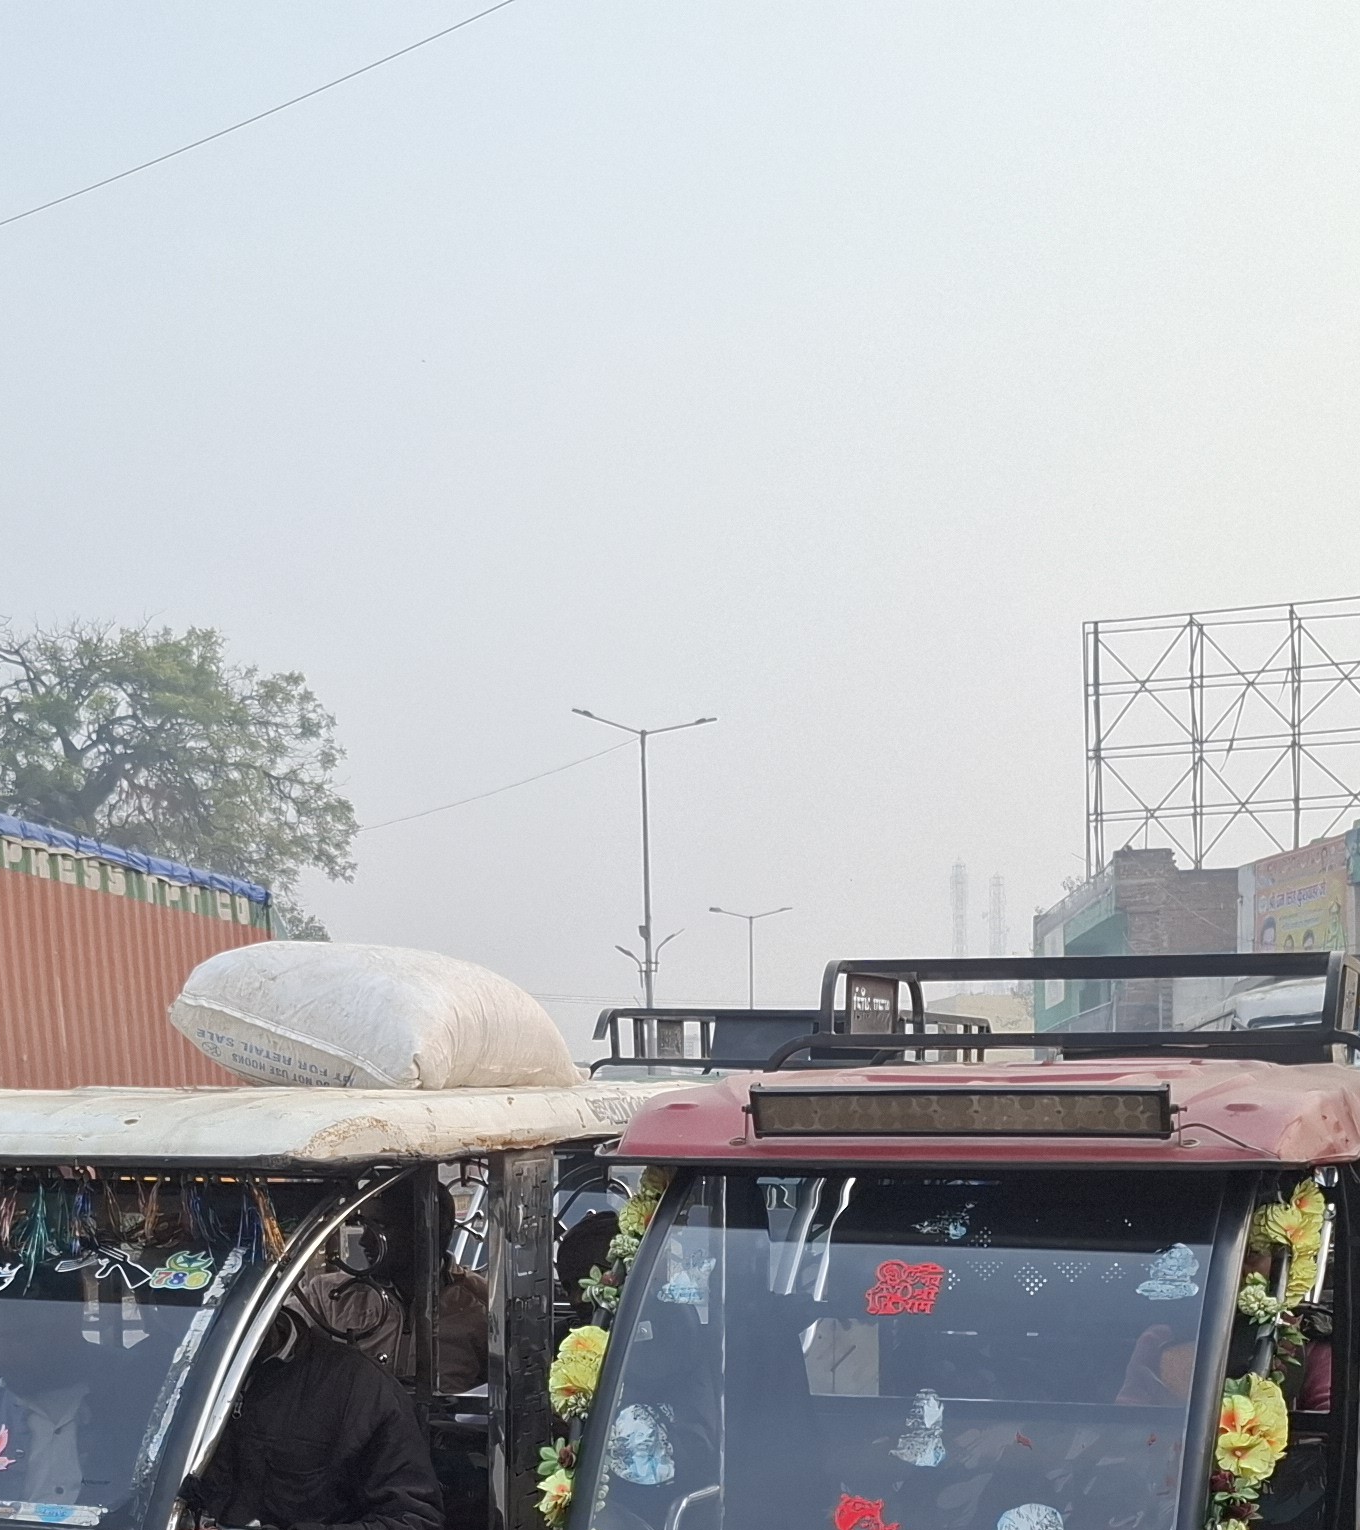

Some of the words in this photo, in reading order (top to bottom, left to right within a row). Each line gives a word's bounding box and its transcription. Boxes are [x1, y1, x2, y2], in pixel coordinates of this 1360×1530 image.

[196, 1027, 235, 1048] SALE
[231, 1053, 266, 1072] HOOKS
[241, 1041, 292, 1066] RETAIL
[269, 1065, 289, 1080] USE
[298, 1060, 328, 1077] FOR
[292, 1073, 313, 1086] NOT
[154, 1271, 209, 1289] 786
